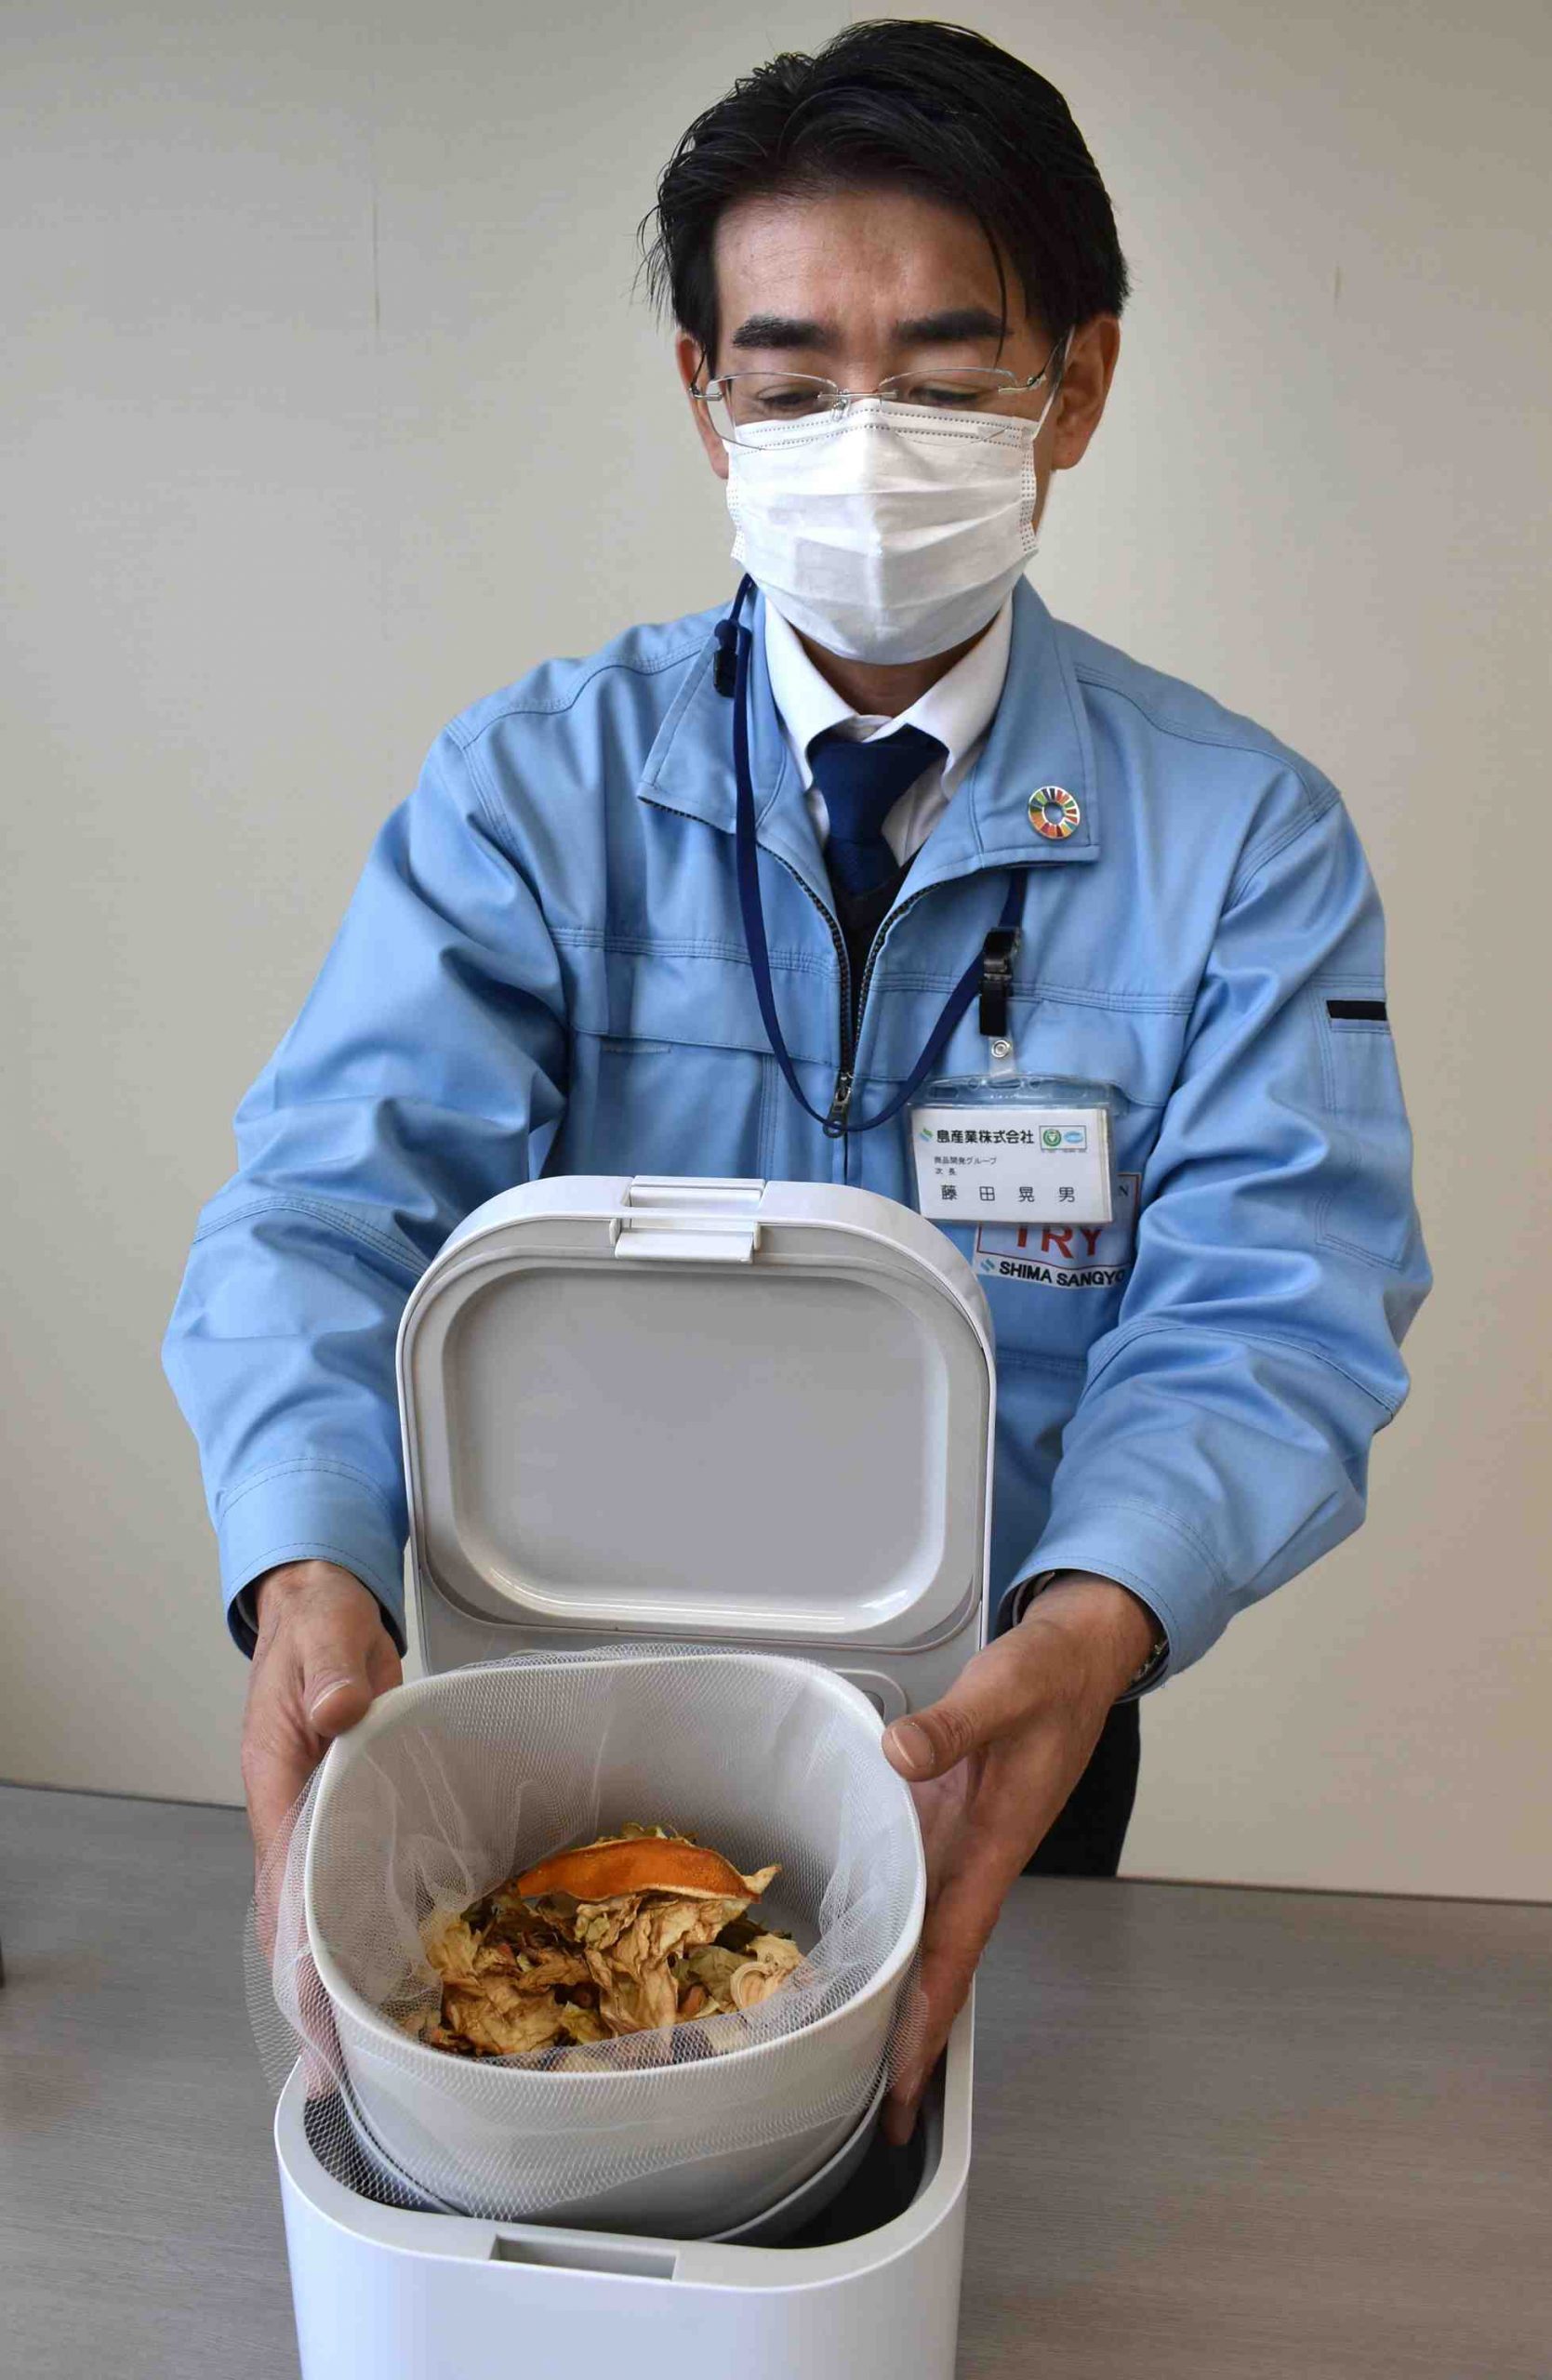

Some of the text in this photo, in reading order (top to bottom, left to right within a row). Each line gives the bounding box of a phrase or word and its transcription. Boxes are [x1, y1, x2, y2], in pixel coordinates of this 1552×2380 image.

[936, 1129, 1035, 1144] 島産業株式会社
[999, 1261, 1126, 1288] SHIMA SANGYO
